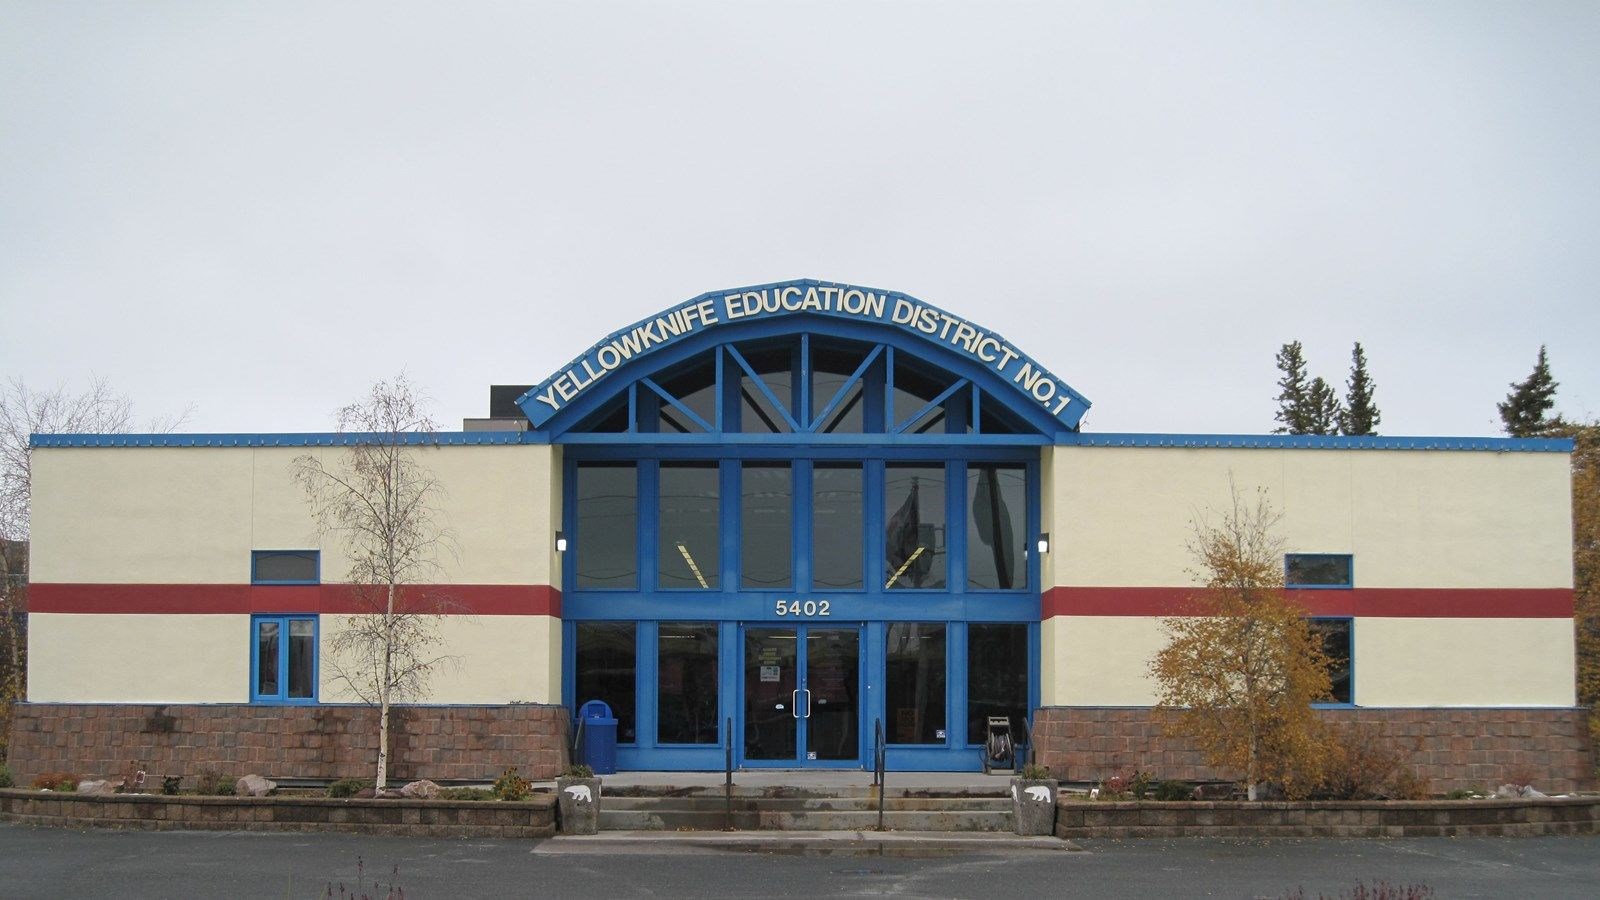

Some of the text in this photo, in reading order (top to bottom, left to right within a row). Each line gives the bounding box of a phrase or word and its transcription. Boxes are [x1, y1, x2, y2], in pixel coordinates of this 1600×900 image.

[536, 299, 719, 411] YELLOWKNIFE
[724, 286, 887, 320] EDUCATION
[891, 298, 1019, 371] DISTRICT
[775, 600, 831, 617] 5402
